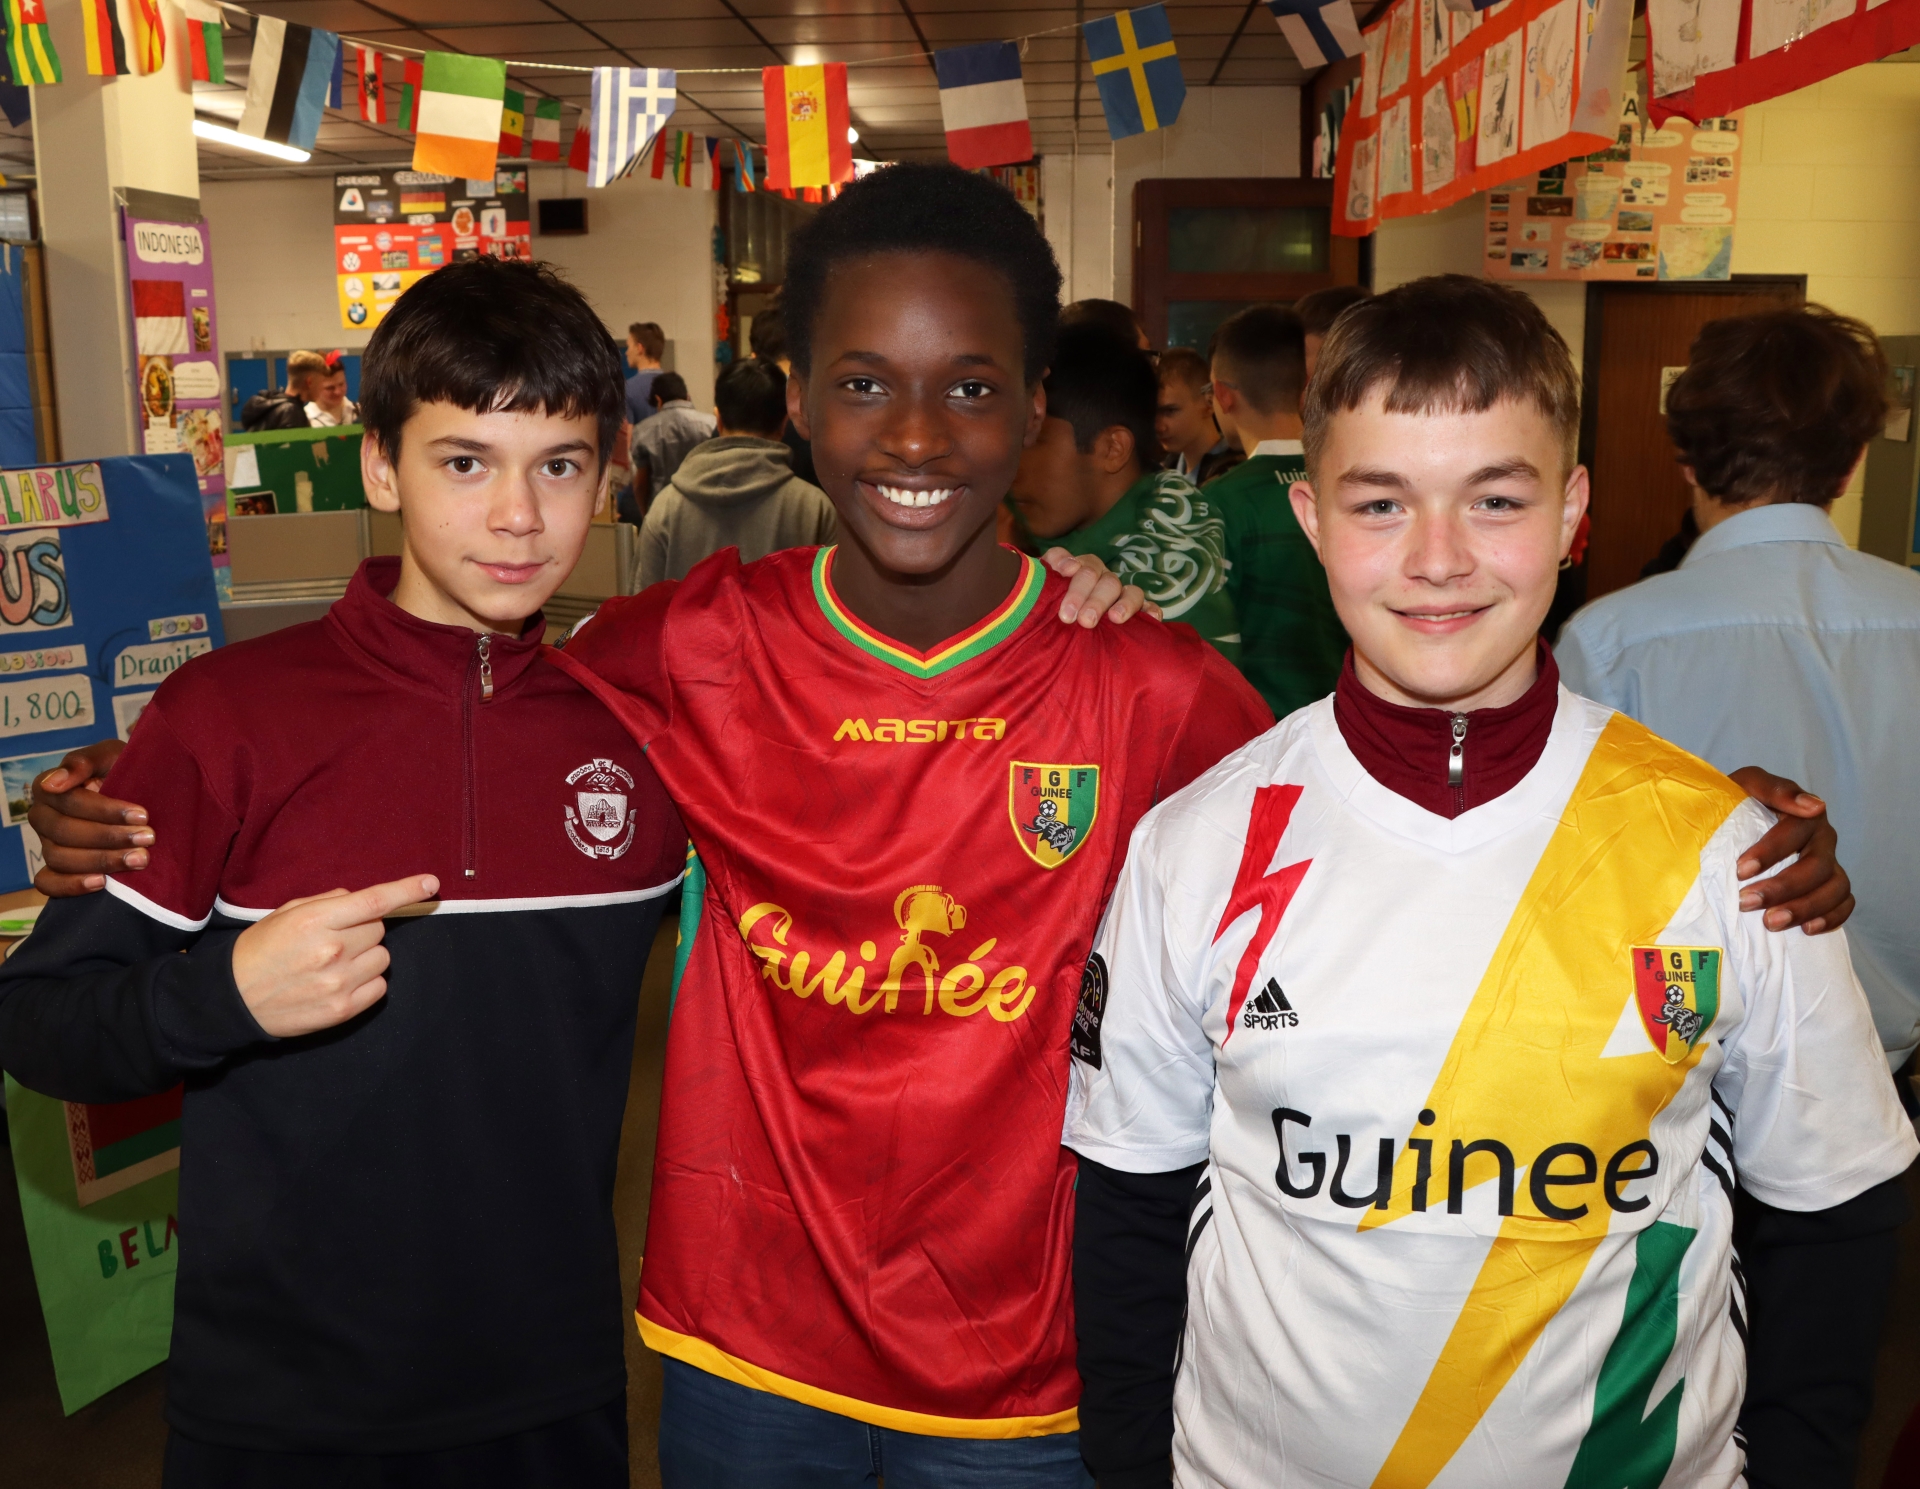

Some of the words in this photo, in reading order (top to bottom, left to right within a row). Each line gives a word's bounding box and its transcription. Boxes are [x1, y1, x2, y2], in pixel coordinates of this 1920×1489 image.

[138, 230, 202, 255] INDONESIA
[0, 465, 101, 524] LARUS
[0, 541, 69, 626] US
[121, 644, 206, 680] Dranik
[1030, 786, 1073, 799] GUINEE
[1655, 970, 1697, 982] GUINEE
[1243, 1011, 1299, 1031] SPORTS
[1271, 1107, 1659, 1221] Guinee
